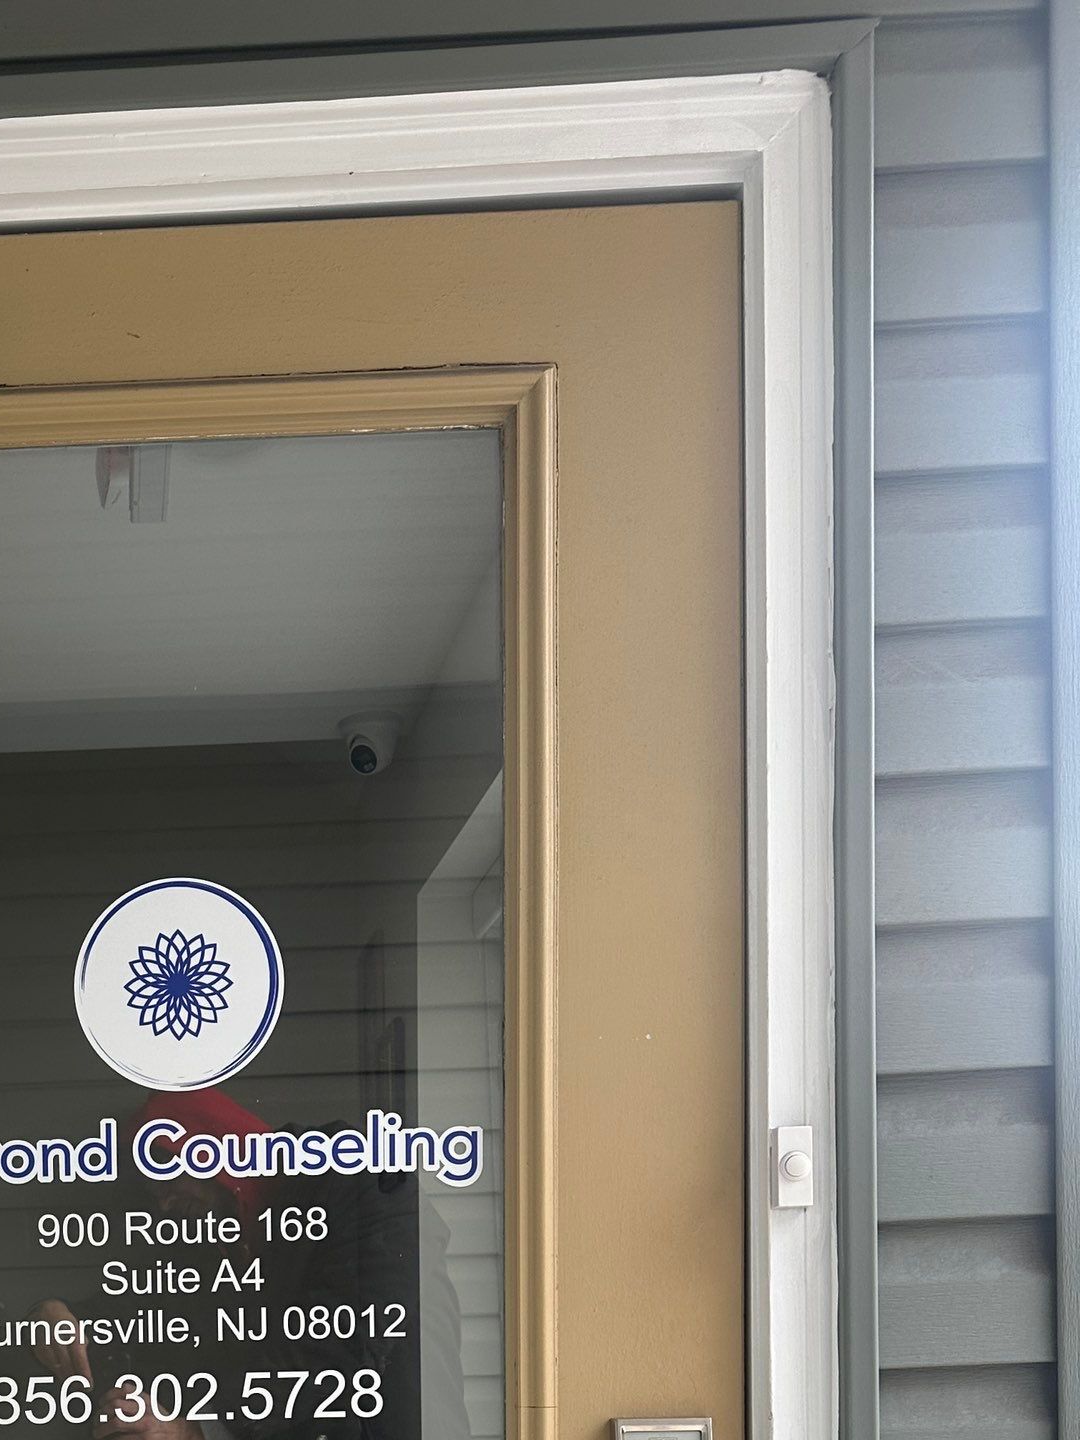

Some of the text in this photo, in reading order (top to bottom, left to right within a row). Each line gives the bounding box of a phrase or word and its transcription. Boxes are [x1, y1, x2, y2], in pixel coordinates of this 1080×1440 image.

[132, 1109, 484, 1188] Counseling
[38, 1206, 328, 1248] 900 Route 168
[101, 1257, 265, 1295] Suite A4
[217, 1306, 267, 1342] NJ
[283, 1303, 406, 1340] 08012
